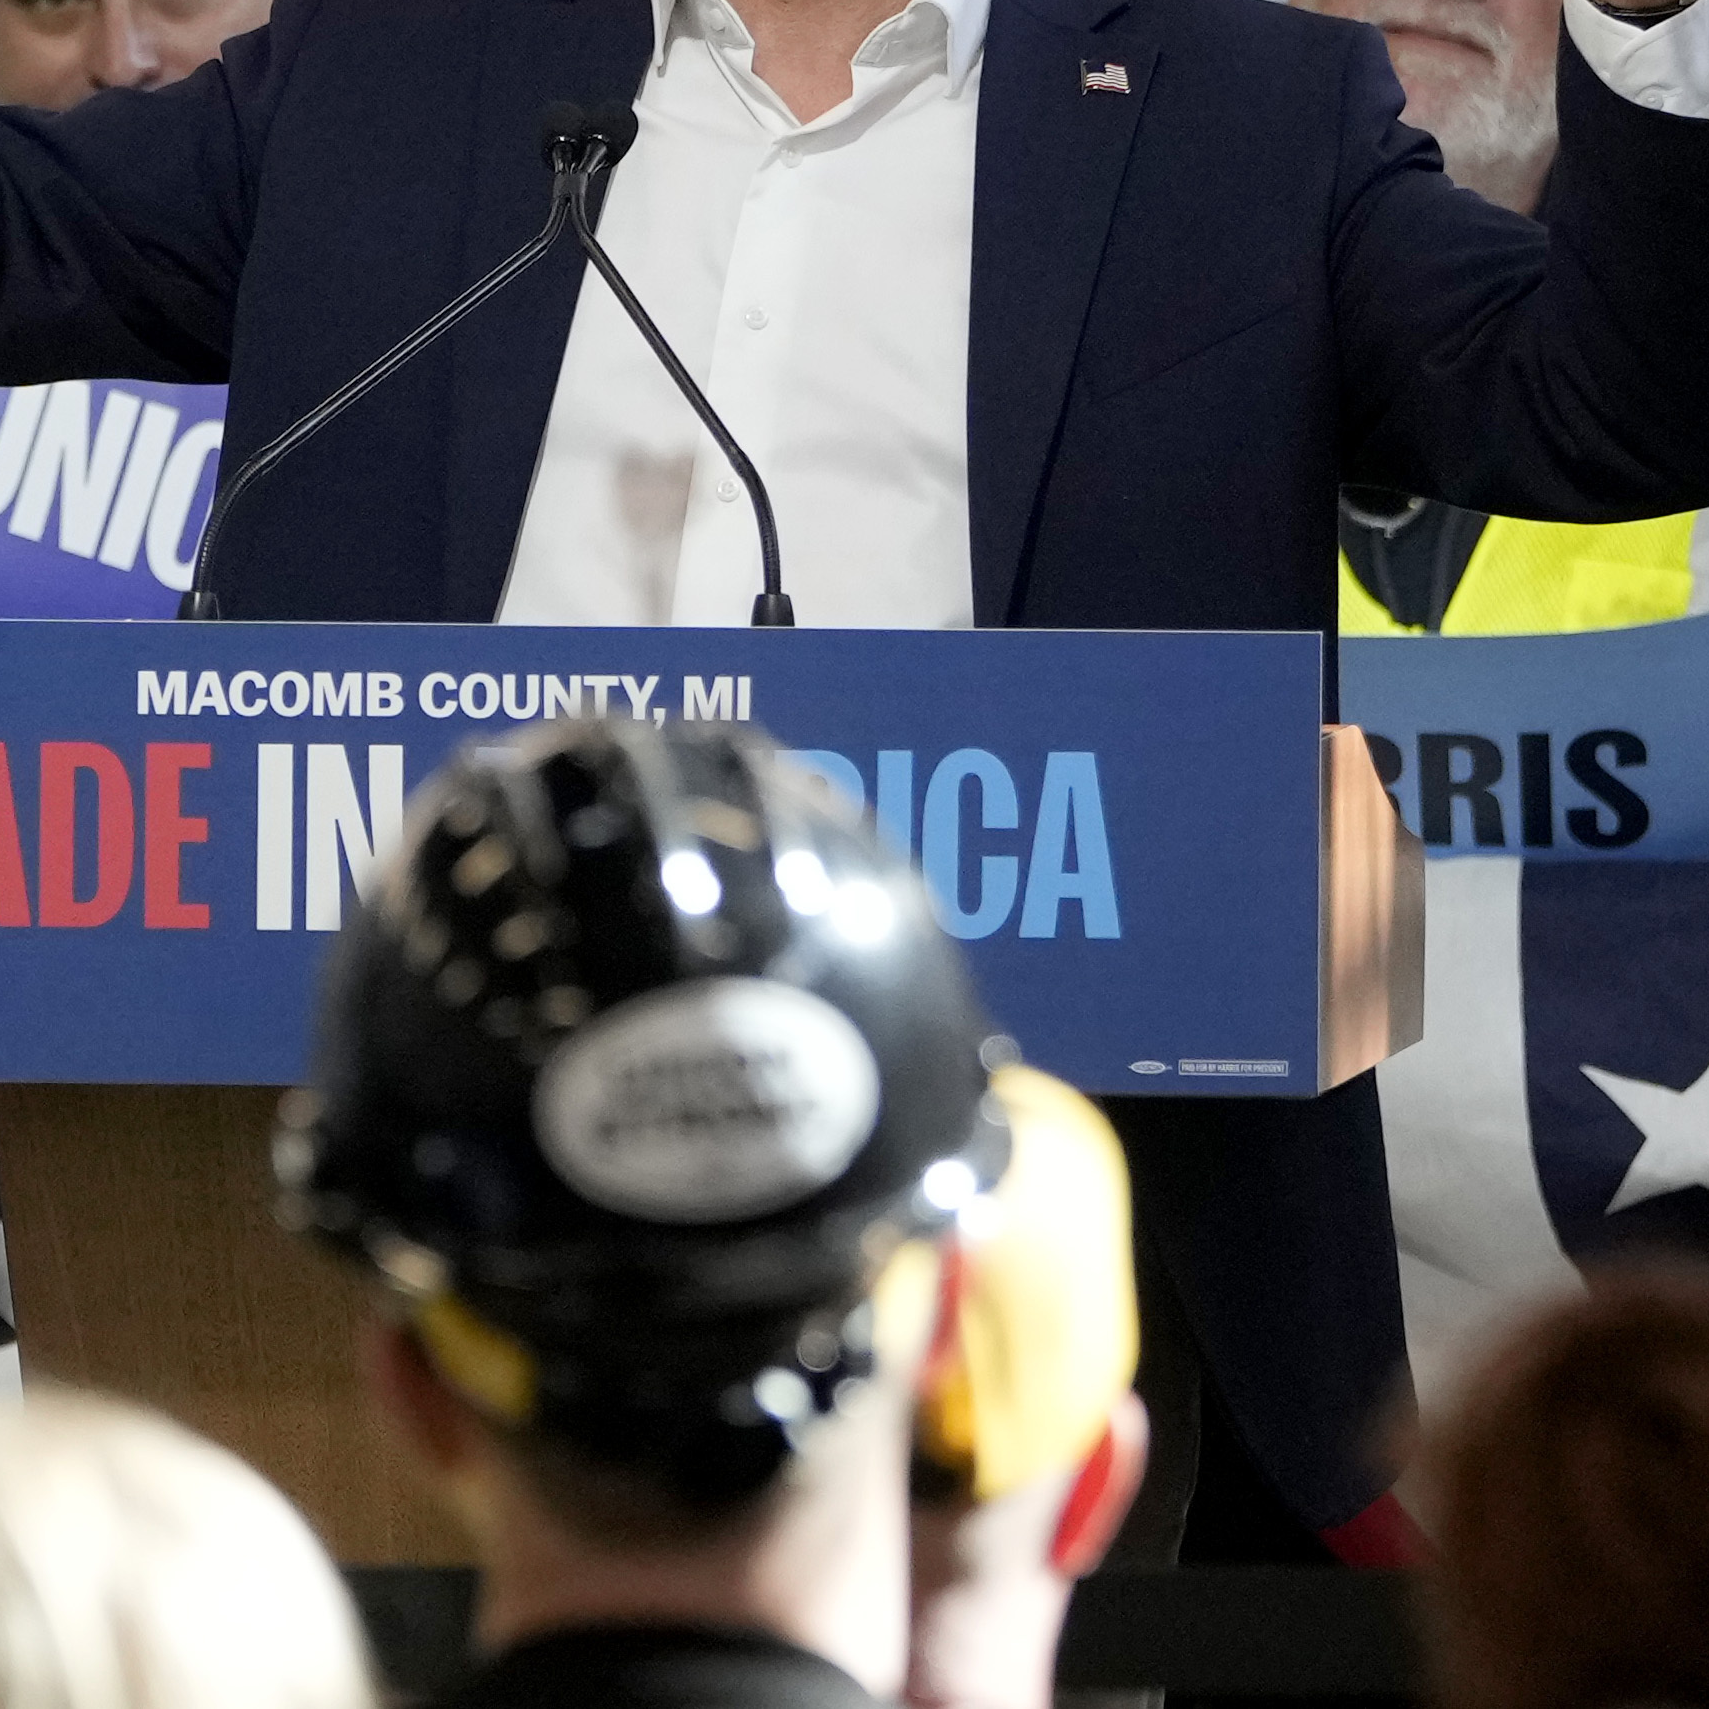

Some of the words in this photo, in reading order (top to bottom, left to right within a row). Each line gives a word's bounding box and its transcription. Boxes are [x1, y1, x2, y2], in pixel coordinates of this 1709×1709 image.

[137, 671, 403, 717] MACOMB
[419, 674, 667, 731] COUNTY,
[682, 676, 751, 722] MI
[256, 744, 403, 931] IN
